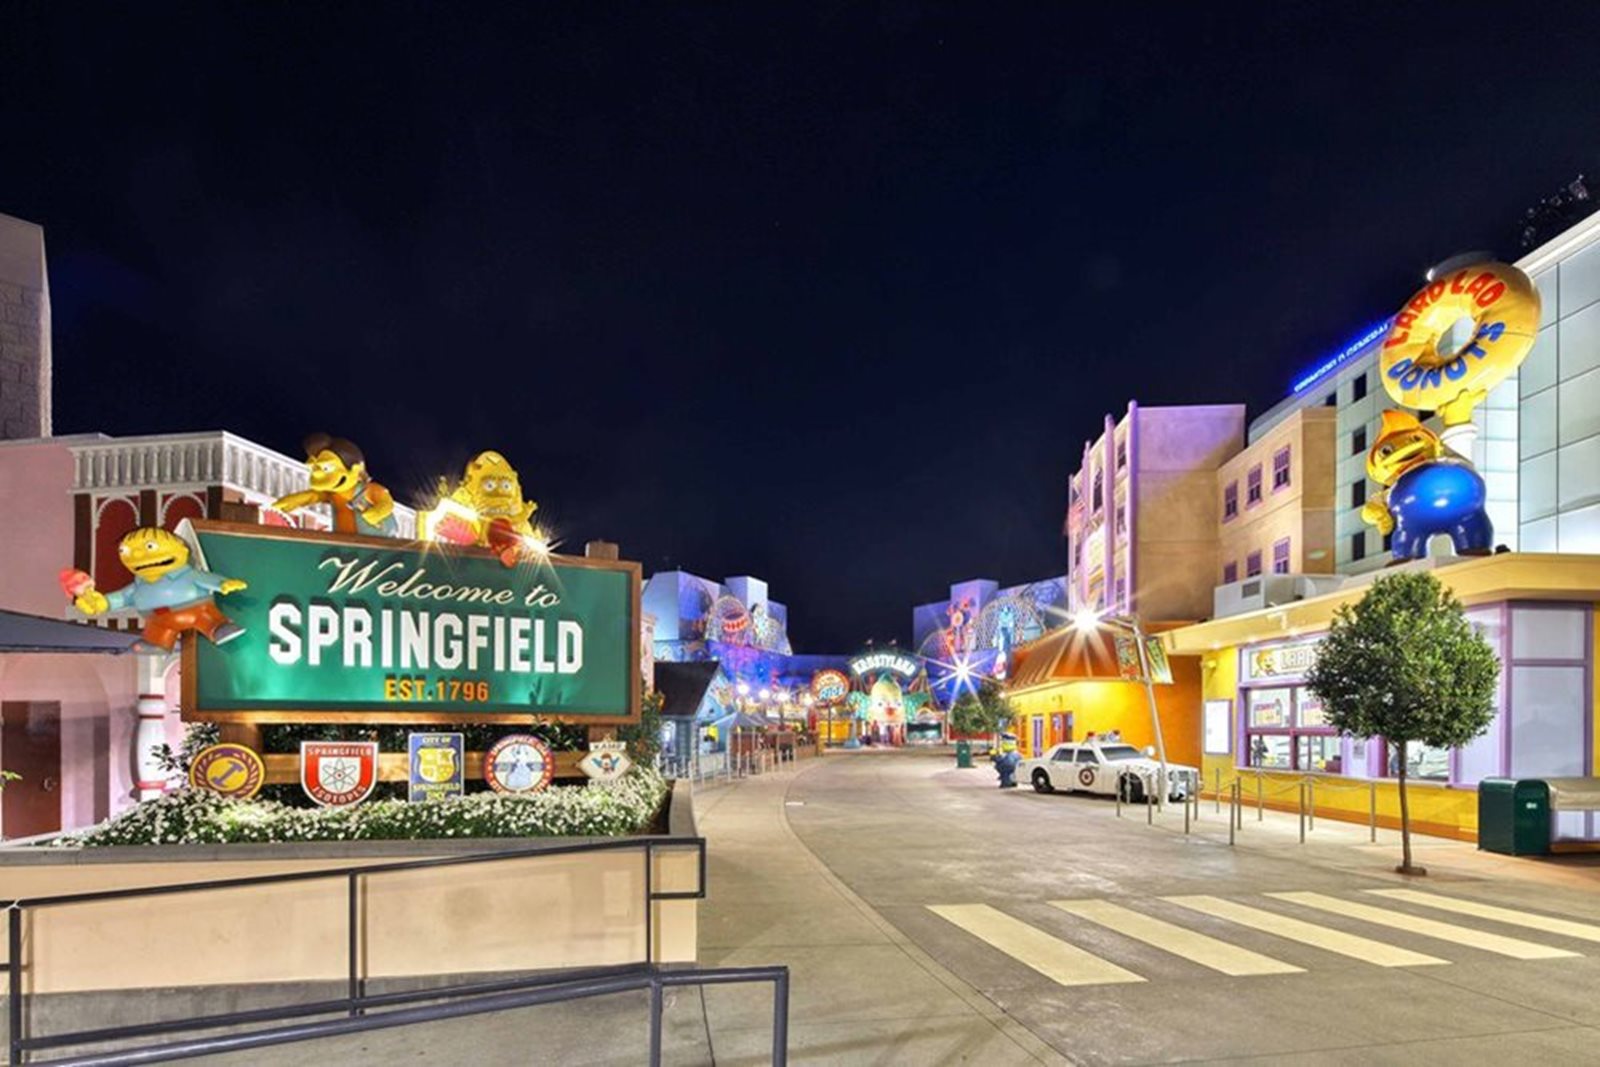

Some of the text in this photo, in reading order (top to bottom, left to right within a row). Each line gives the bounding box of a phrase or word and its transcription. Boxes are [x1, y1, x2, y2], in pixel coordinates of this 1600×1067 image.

[1384, 279, 1446, 349] LARD
[1450, 270, 1505, 308] LAD
[1387, 321, 1506, 391] DONUTS
[318, 556, 560, 608] Welcome to
[268, 602, 583, 674] SPRINGFIELD
[853, 654, 916, 676] KRUSTYLAND
[306, 745, 372, 757] SPRINGFIELD
[311, 785, 367, 804] ISOTOPES
